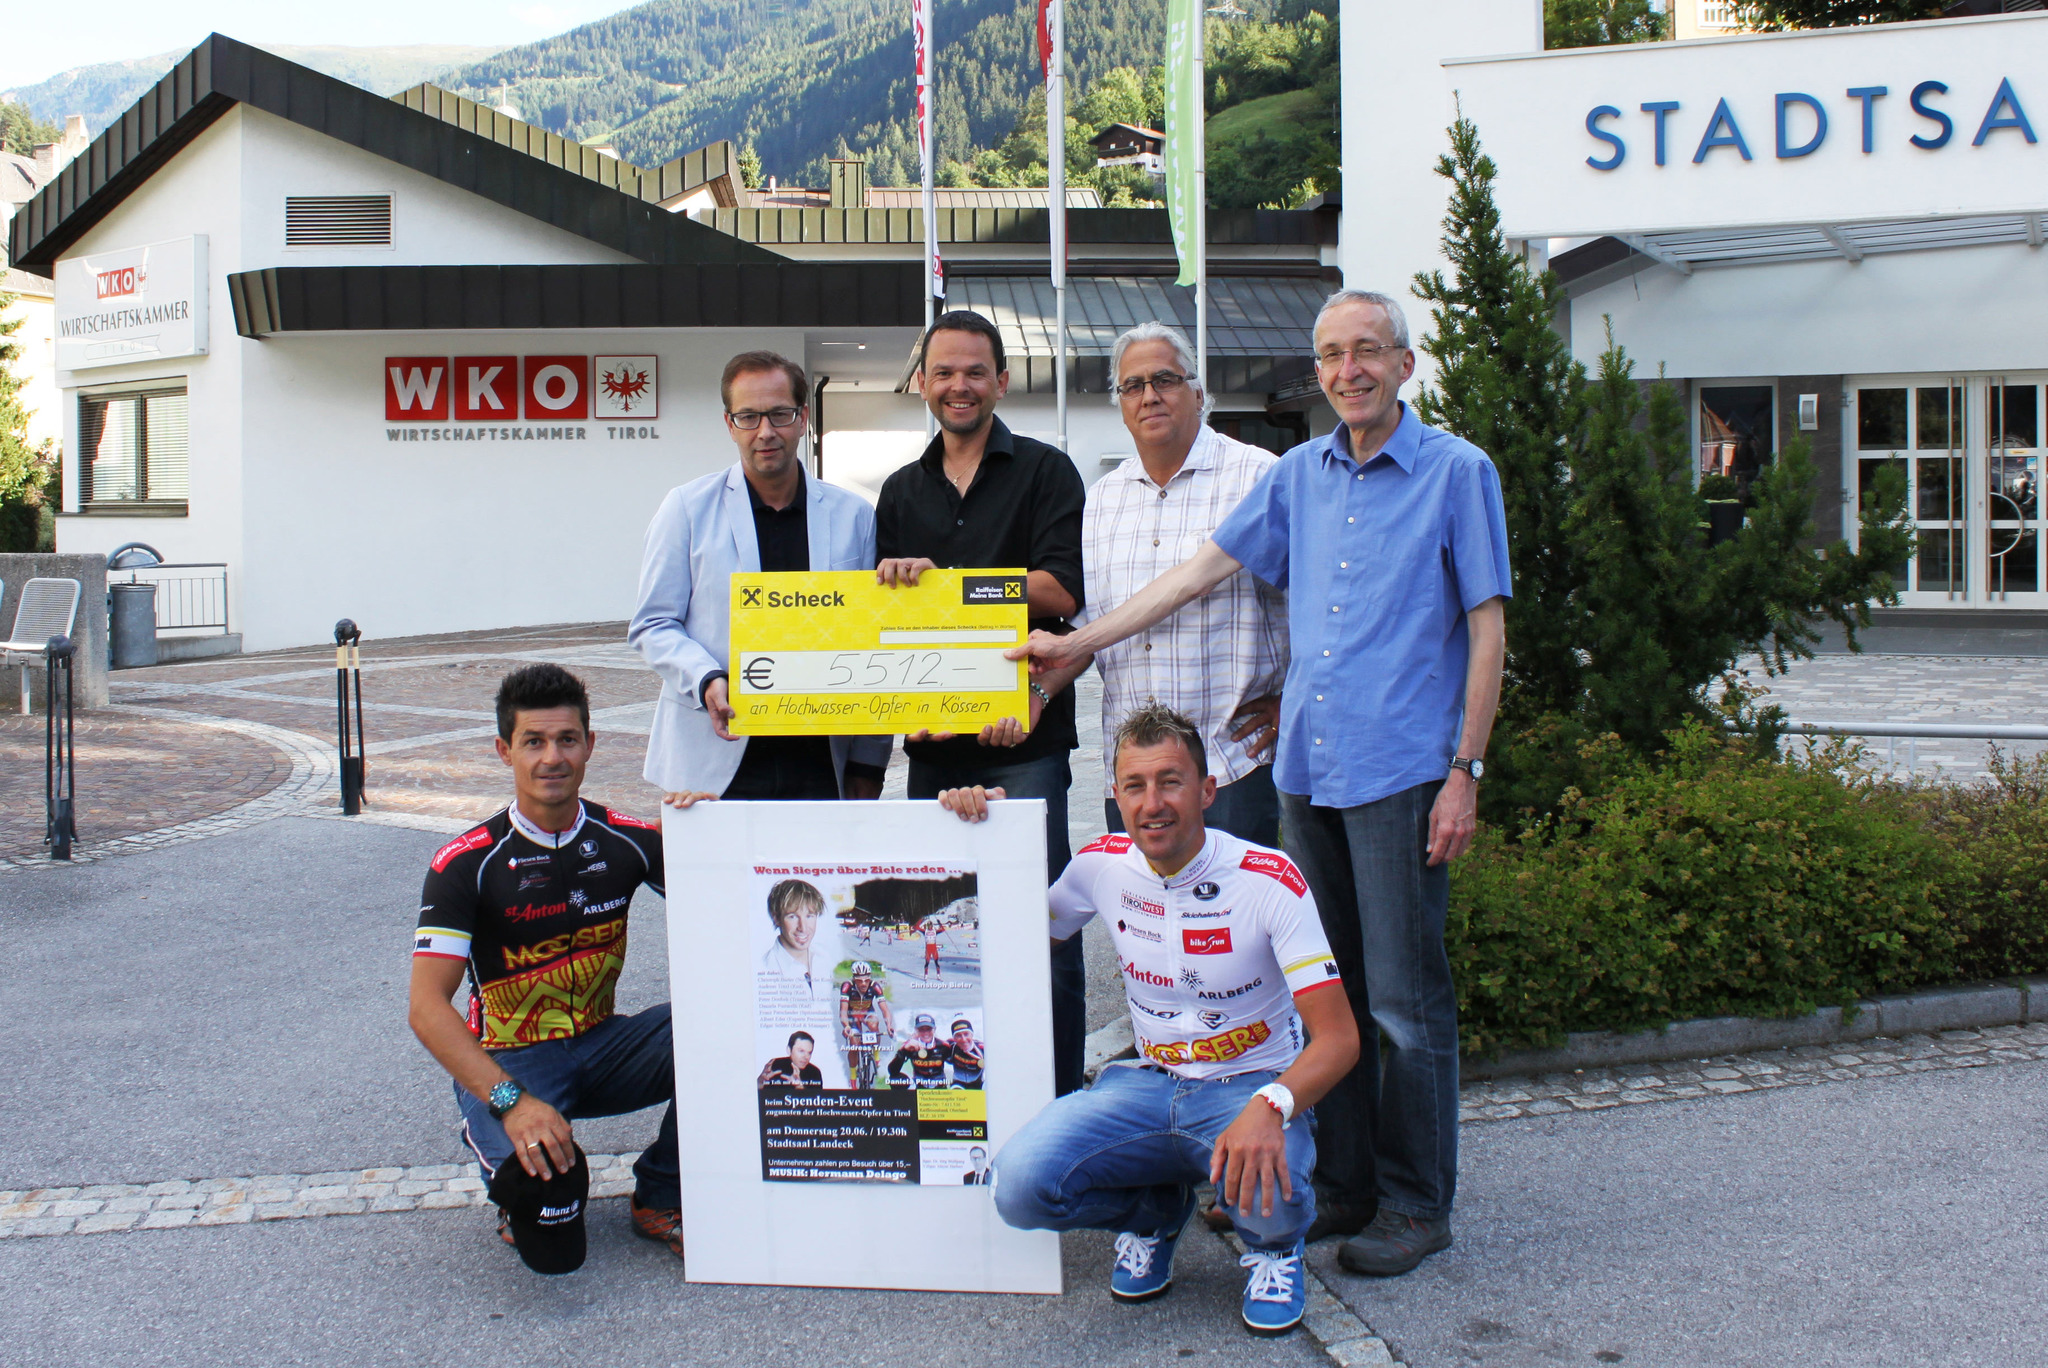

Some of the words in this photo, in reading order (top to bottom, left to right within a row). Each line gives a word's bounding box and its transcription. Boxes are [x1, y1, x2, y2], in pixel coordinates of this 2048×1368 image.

[1584, 76, 2039, 172] STADTSA
[97, 269, 135, 297] WKO
[60, 300, 190, 337] WIRTSCHAFTSKAMMER
[387, 363, 580, 412] WKO
[386, 427, 587, 442] WIRTSCHAFTSKAMMER
[606, 426, 660, 440] TIROL
[767, 590, 846, 608] Scheck
[749, 702, 769, 715] an
[917, 701, 930, 714] in
[940, 694, 991, 715] Kössen
[468, 831, 489, 844] SPORT
[587, 861, 607, 872] HEISS
[753, 866, 791, 875] Wenn
[792, 865, 835, 876] Sieger
[837, 865, 868, 874] über
[870, 865, 903, 874] Ziele
[906, 866, 946, 874] reden
[1285, 870, 1306, 891] SPORT
[583, 896, 627, 915] ARLBERG
[501, 918, 625, 970] MOOSER
[1189, 938, 1207, 946] bike
[1211, 938, 1225, 946] run
[910, 981, 948, 990] Christoph
[1198, 977, 1263, 1000] ARLBERG
[784, 1095, 874, 1108] Spenden-Event
[765, 1109, 801, 1117] zugunsten
[816, 1109, 883, 1118] Hochwasser-Opfer
[883, 1109, 891, 1117] in
[893, 1109, 911, 1117] Tirol
[784, 1126, 838, 1137] Donnerstag
[840, 1127, 868, 1136] 20.06.
[876, 1127, 908, 1136] 19.30h
[767, 1139, 811, 1148] Stadtsaal
[813, 1139, 854, 1148] Landeck
[768, 1159, 814, 1167] Unternehmen
[814, 1159, 838, 1167] zahlen
[769, 1168, 809, 1177] MUSIK:
[810, 1169, 864, 1178] Hermann
[865, 1169, 907, 1180] Delago
[539, 1205, 571, 1218] Allianz
